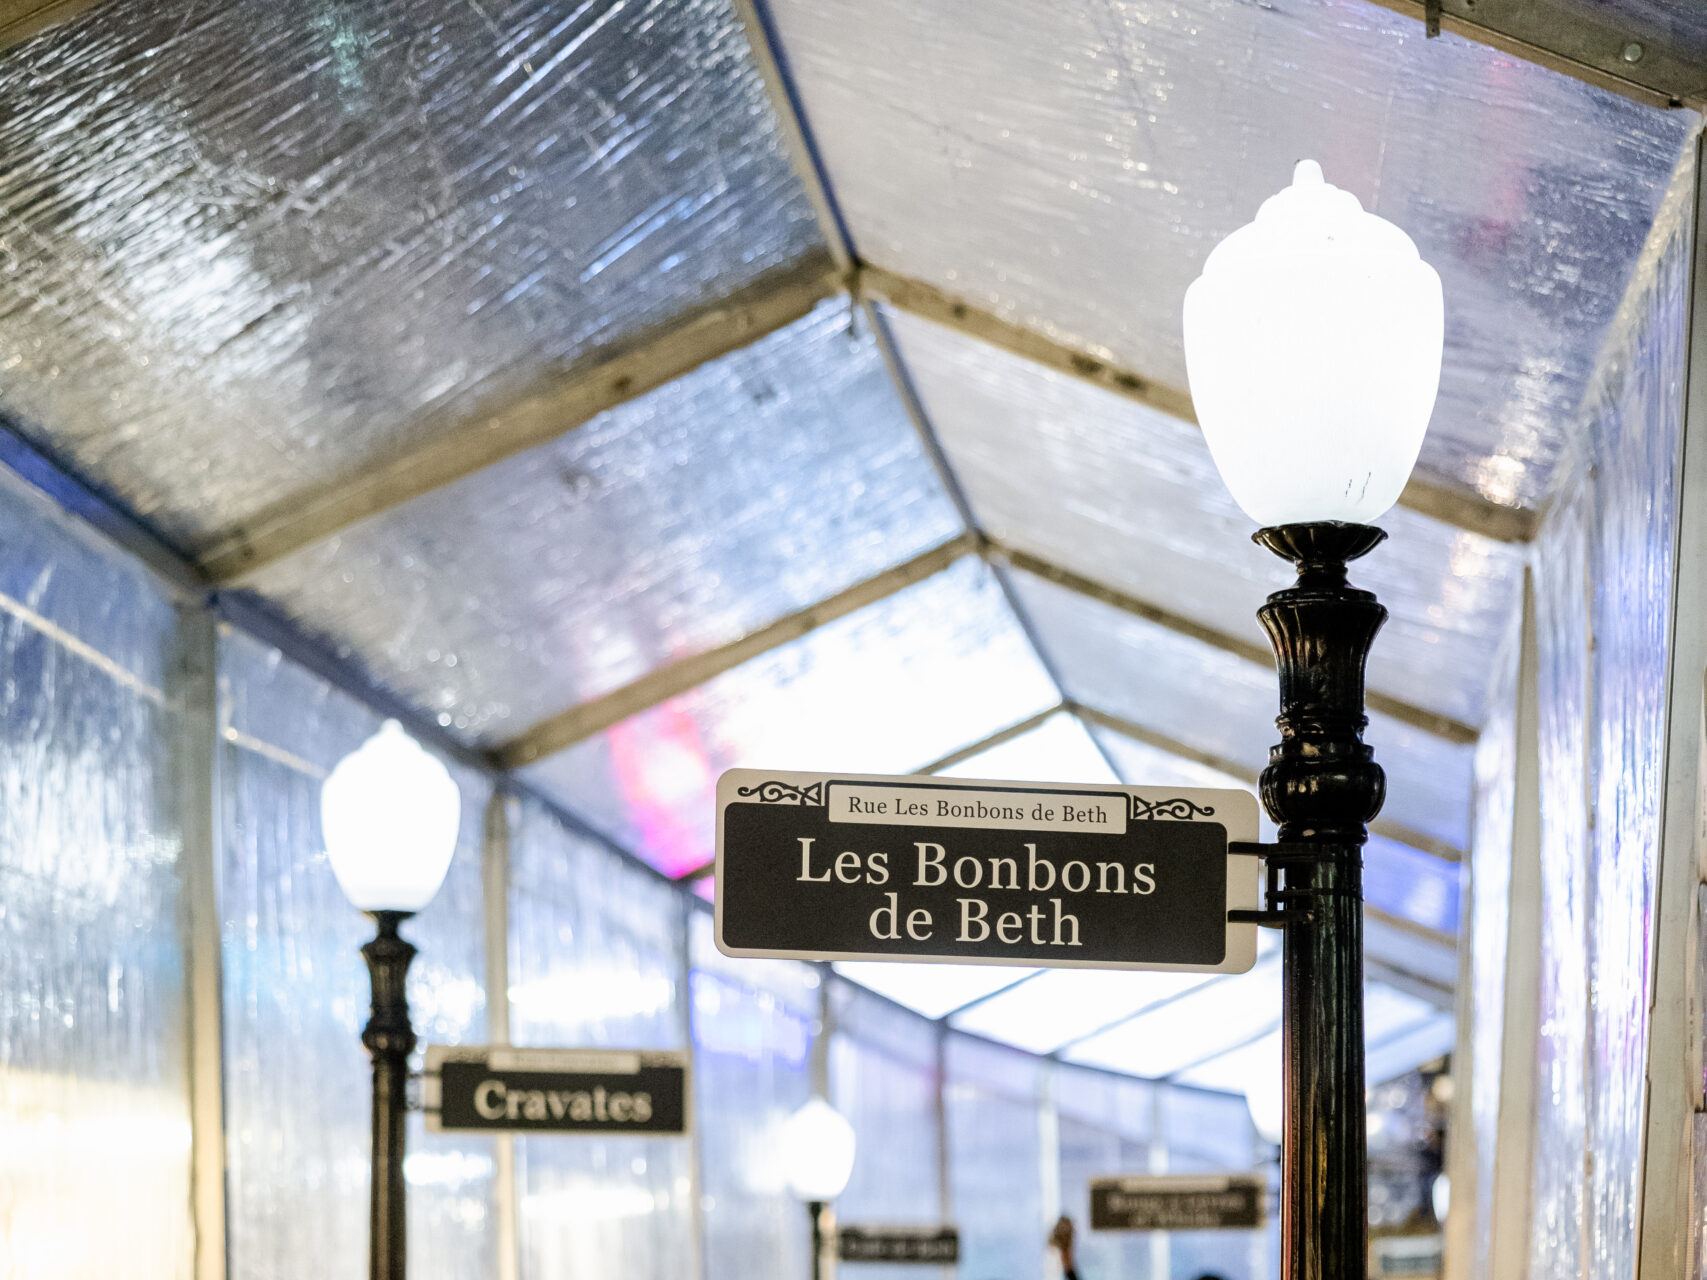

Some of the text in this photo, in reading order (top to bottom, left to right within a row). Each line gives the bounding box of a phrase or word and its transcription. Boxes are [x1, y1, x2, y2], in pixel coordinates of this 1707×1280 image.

[848, 796, 1107, 824] Rue Les Bonbons de Beth
[796, 838, 1157, 895] Les Bonbons
[869, 893, 1082, 946] de Beth
[474, 1079, 652, 1122] Cravates
